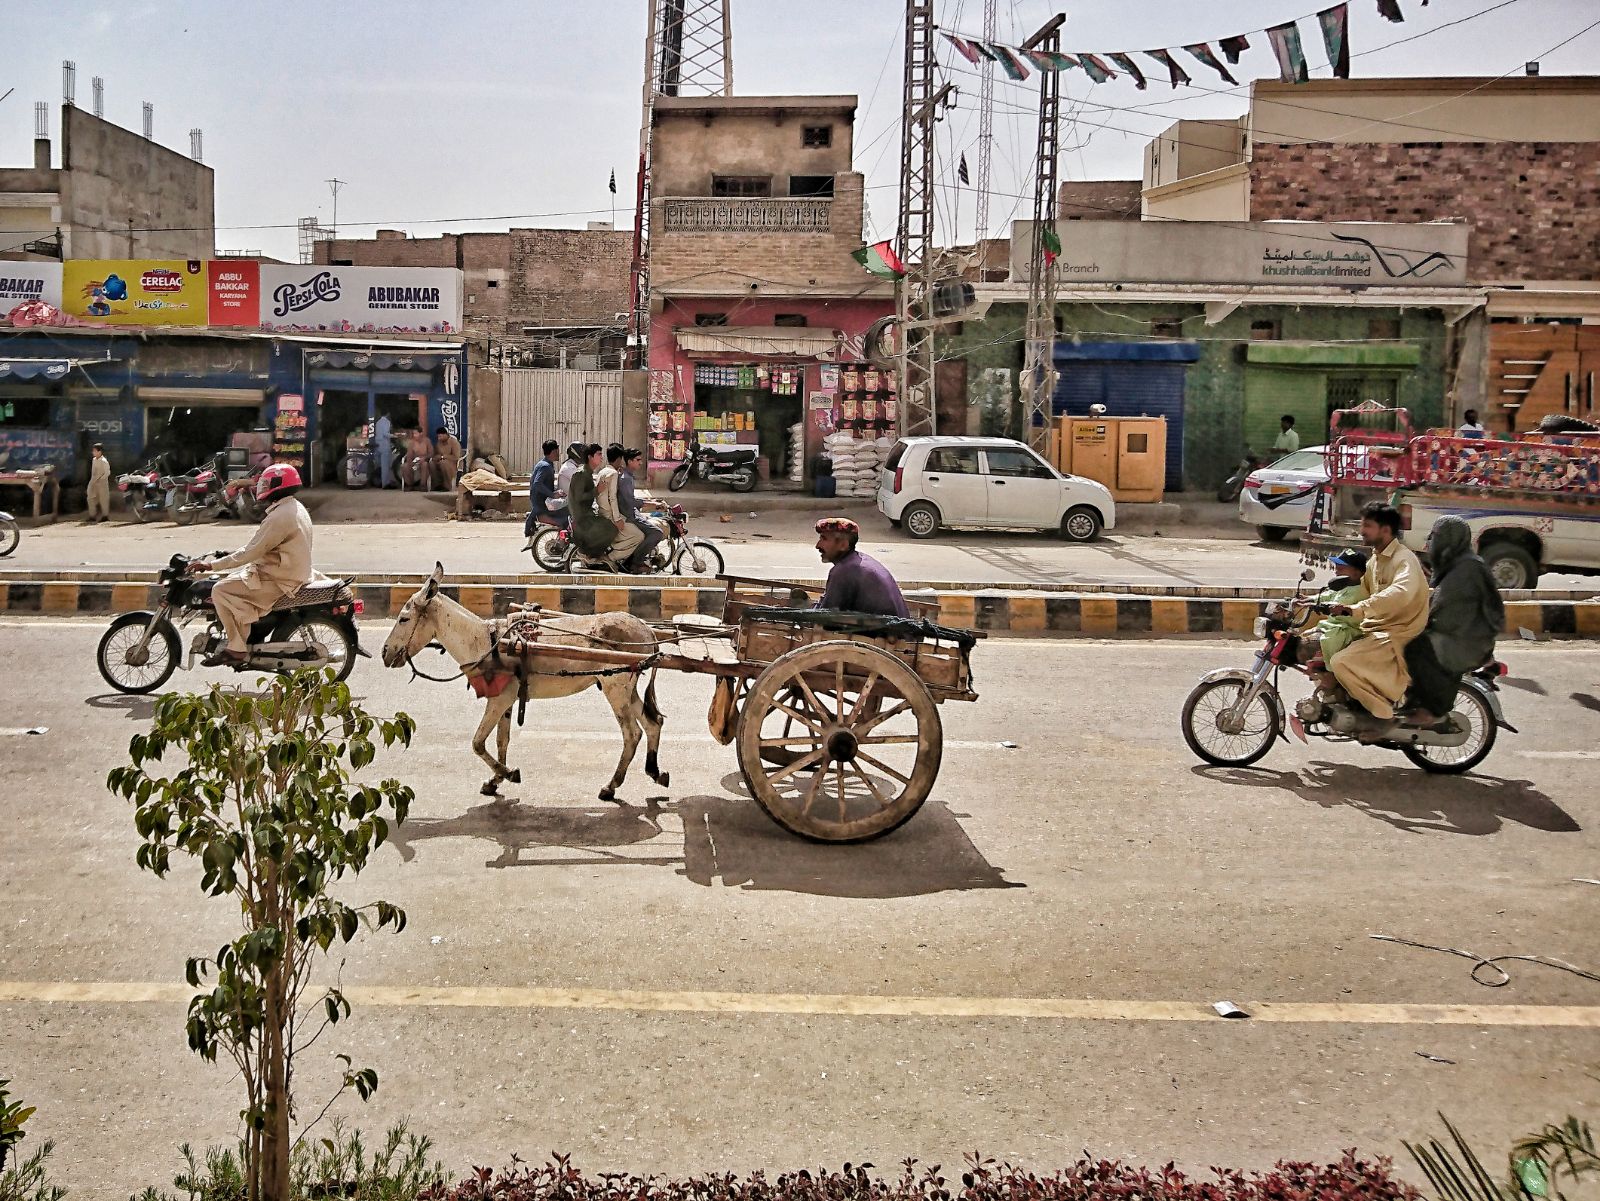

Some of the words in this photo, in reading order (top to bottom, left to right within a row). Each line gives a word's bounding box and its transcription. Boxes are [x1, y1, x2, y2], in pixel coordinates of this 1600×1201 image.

[1062, 262, 1099, 273] Branch
[140, 276, 183, 287] CERELAC
[218, 273, 242, 281] ABBU
[214, 283, 250, 291] BAKKAR
[368, 286, 440, 303] ABUBAKAR
